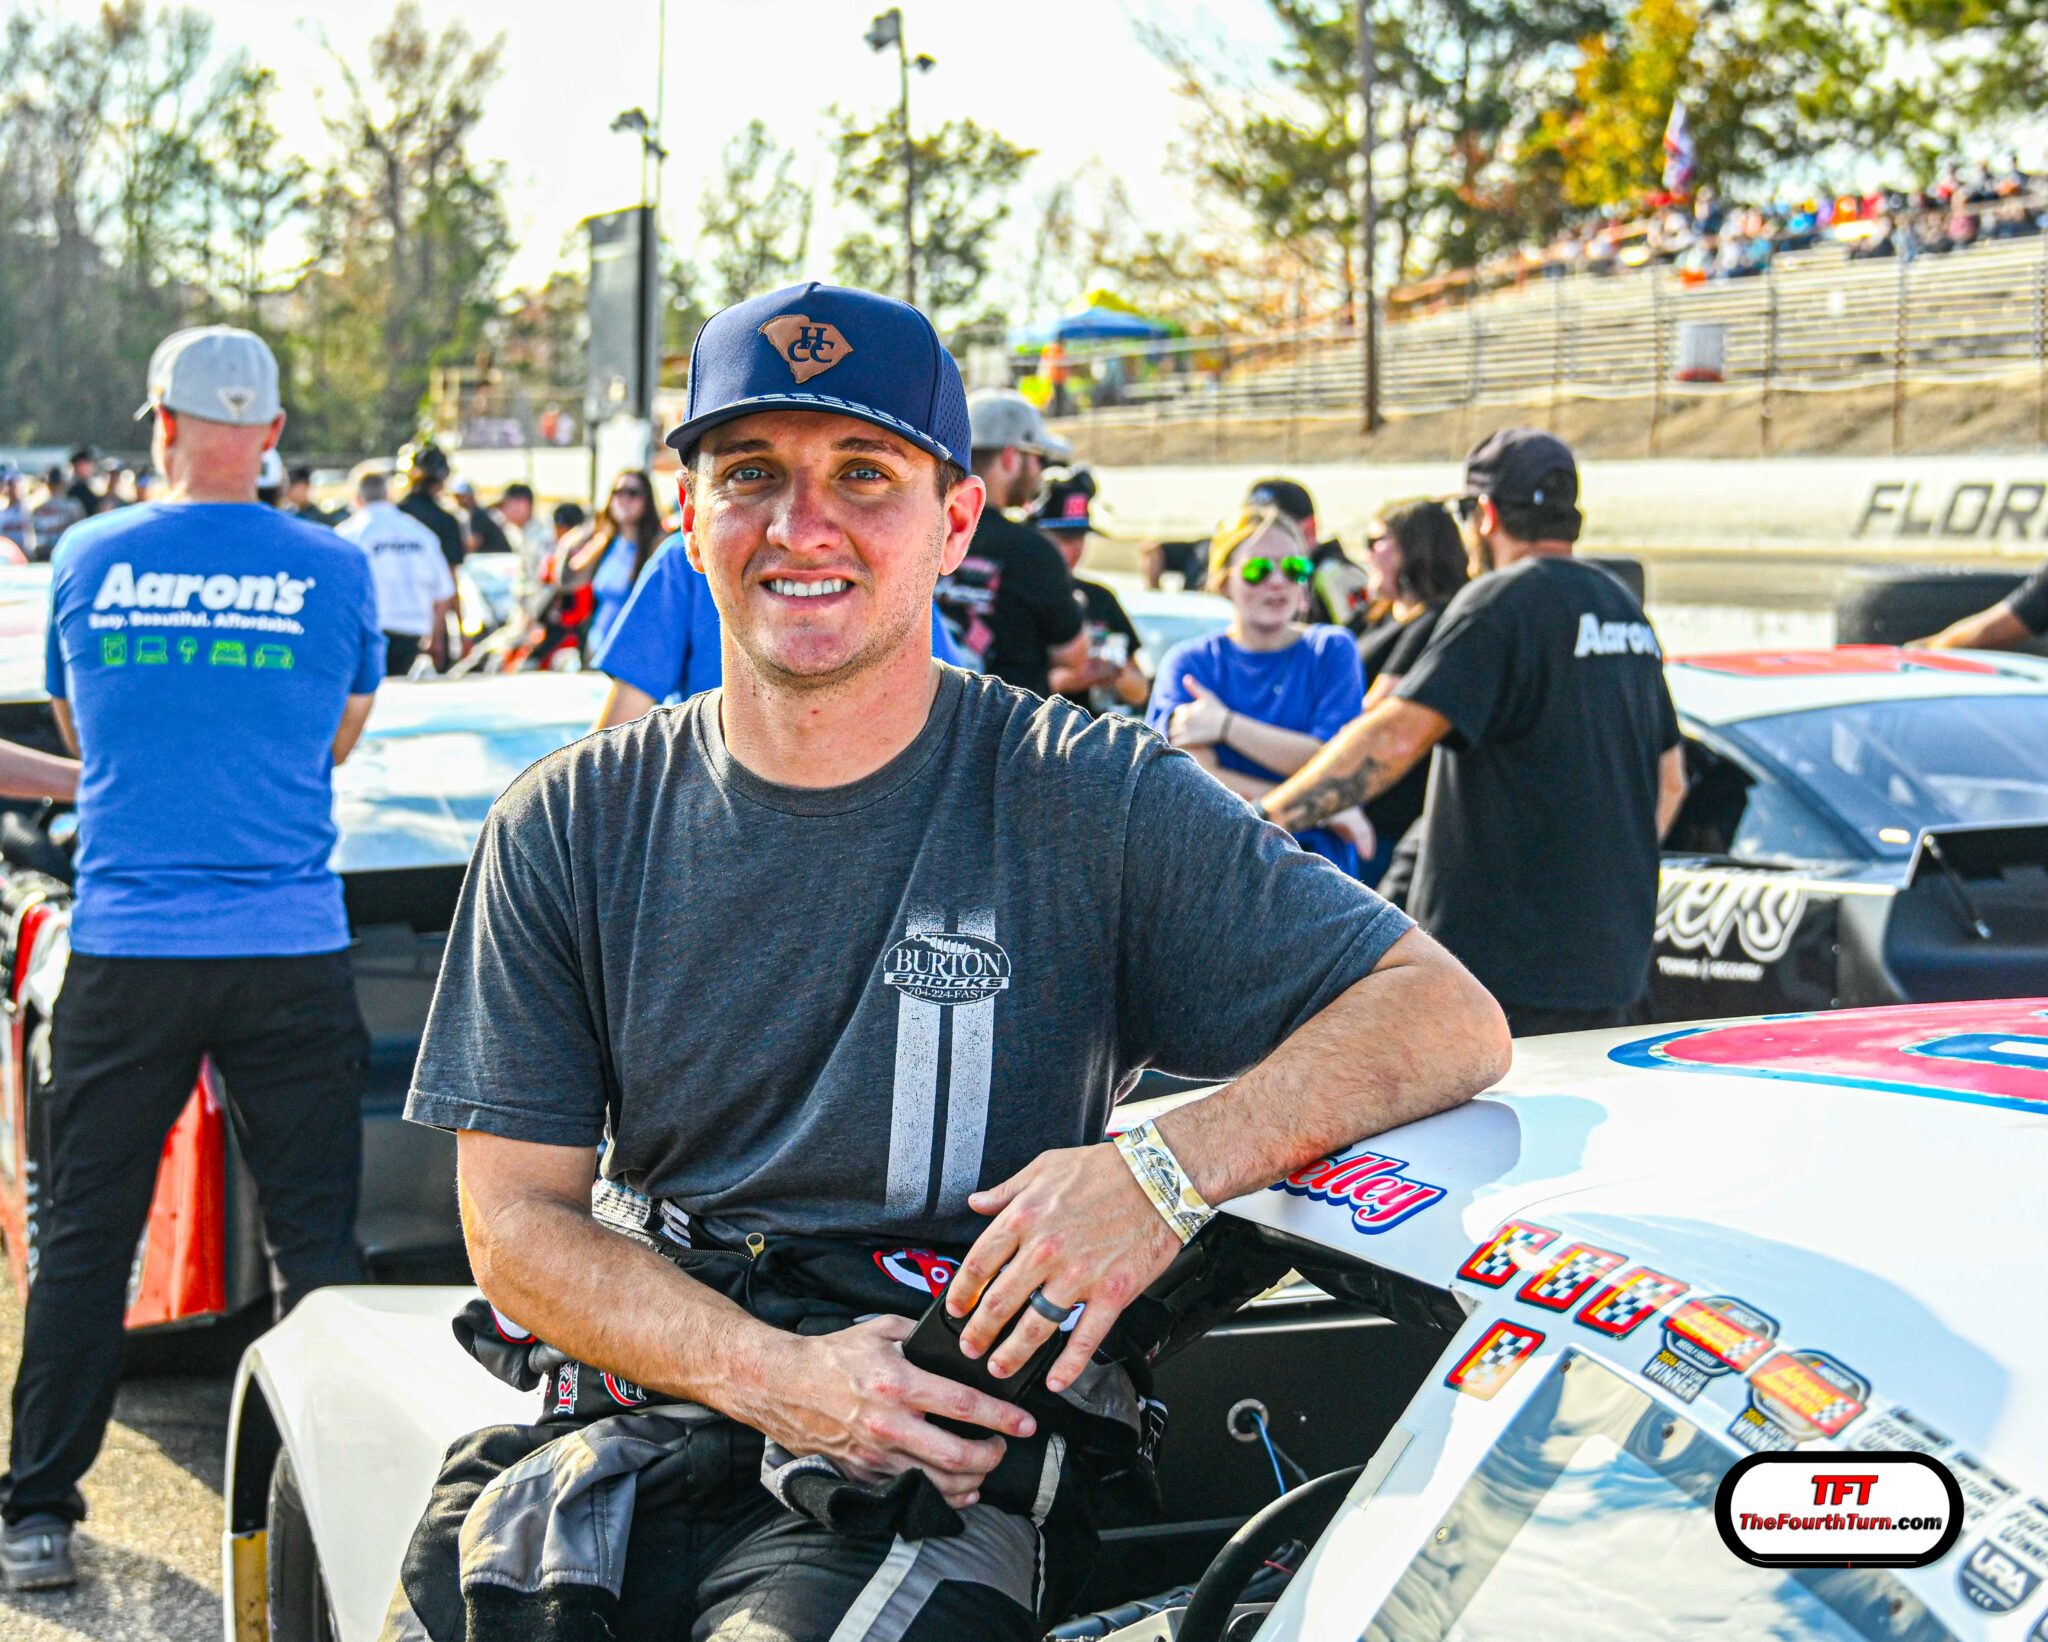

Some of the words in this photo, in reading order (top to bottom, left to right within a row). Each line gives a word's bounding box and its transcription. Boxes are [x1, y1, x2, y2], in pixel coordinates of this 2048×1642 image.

[1852, 481, 2048, 539] FLOR
[1573, 612, 1661, 658] Aaron
[890, 973, 1004, 989] SHOCKS
[893, 948, 1003, 979] BURTON
[908, 986, 988, 999] 704-224-FAST
[1276, 1146, 1447, 1235] elley
[1643, 1358, 1700, 1401] WINNER
